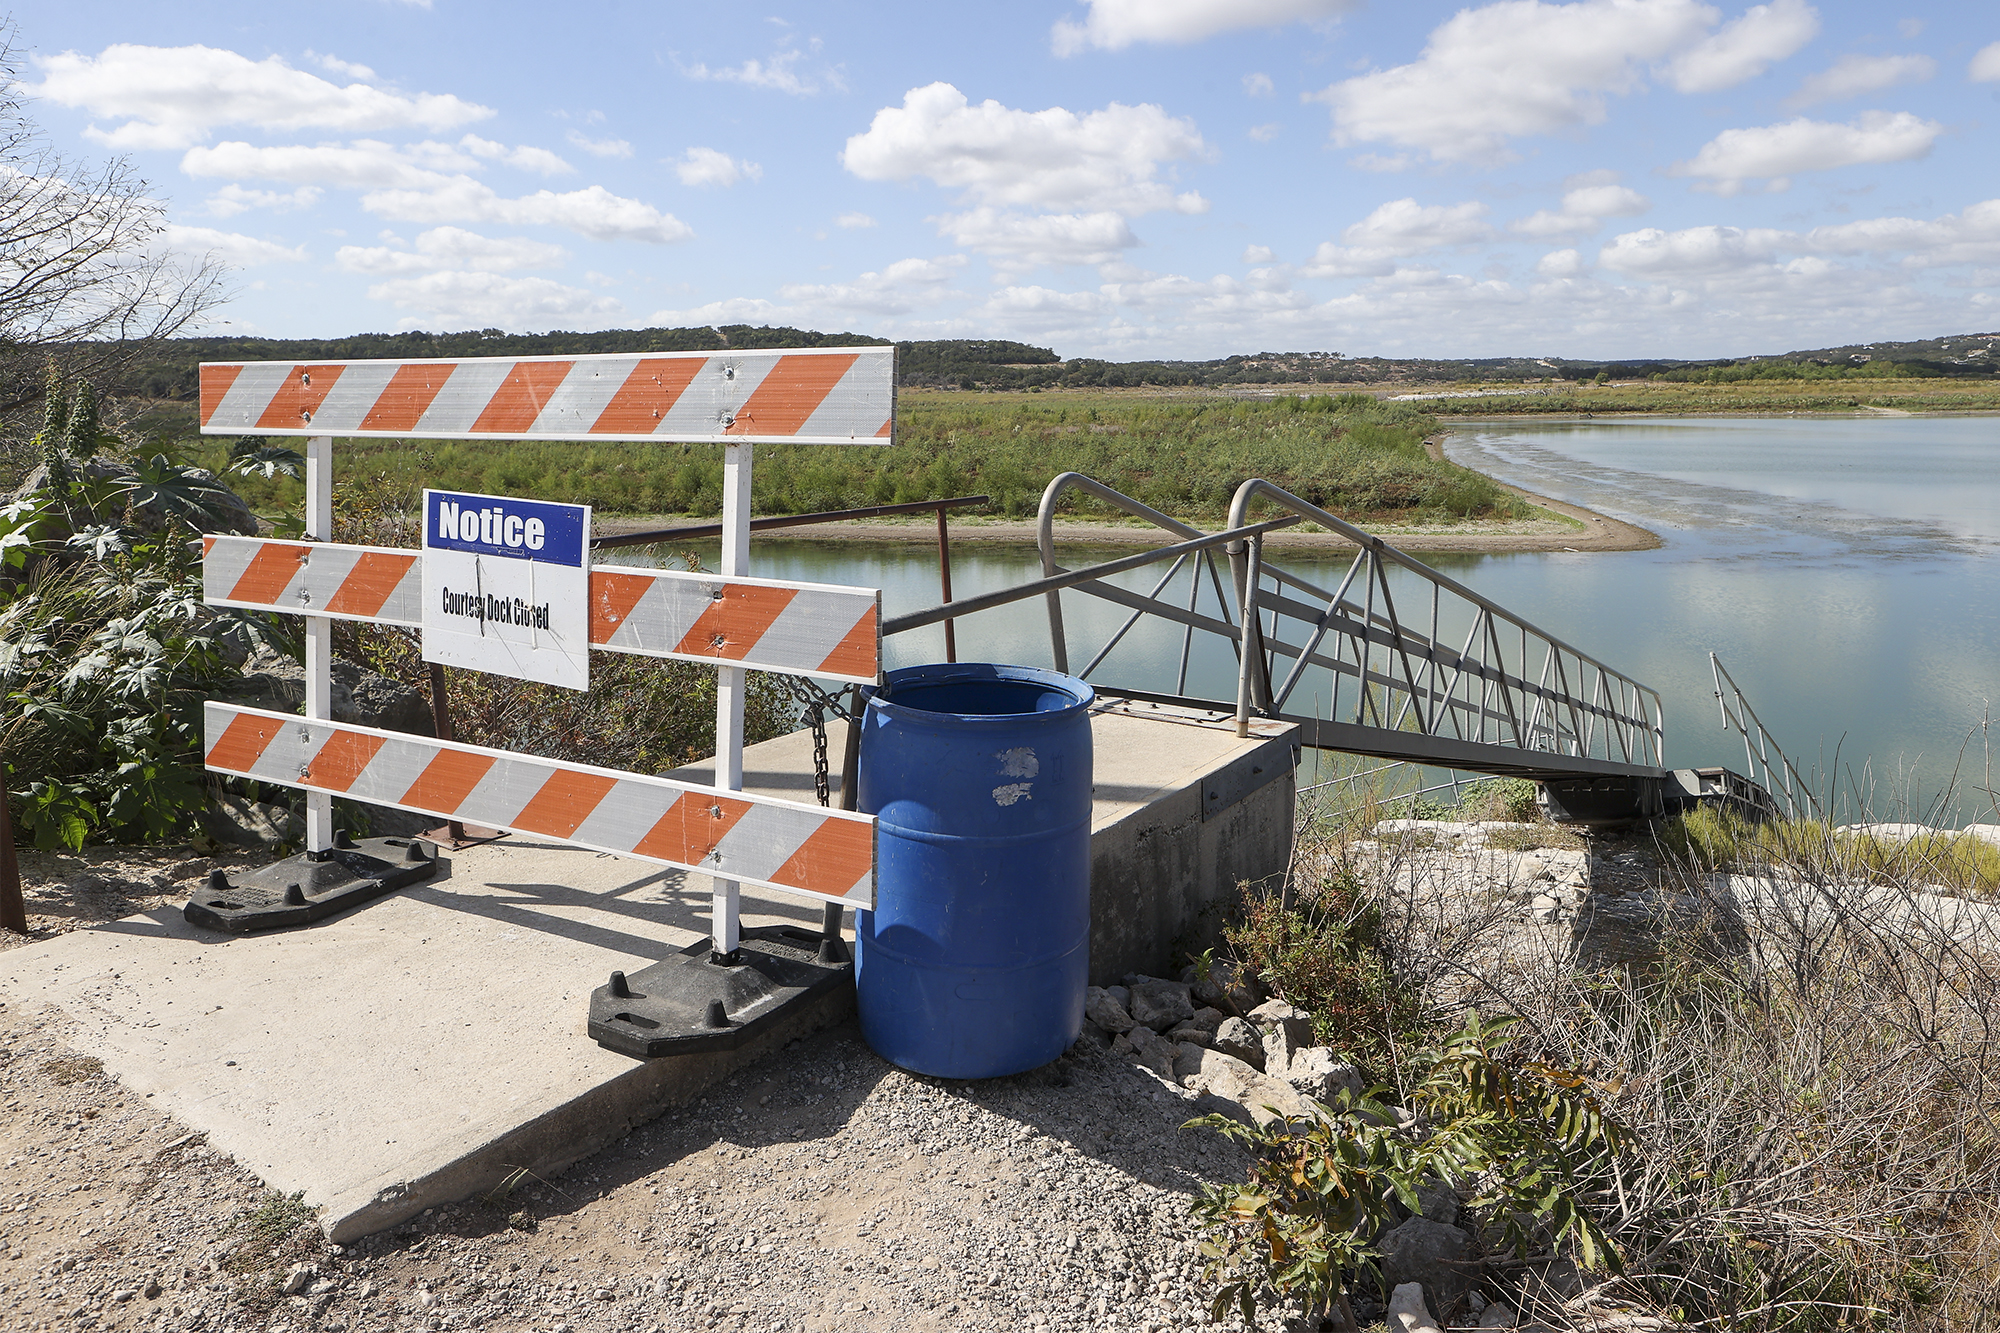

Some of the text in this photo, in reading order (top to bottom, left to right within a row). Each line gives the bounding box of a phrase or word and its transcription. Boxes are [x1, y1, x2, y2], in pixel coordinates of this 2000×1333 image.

[439, 501, 545, 550] Notice
[443, 587, 549, 630] Courtesy Dock Closed
